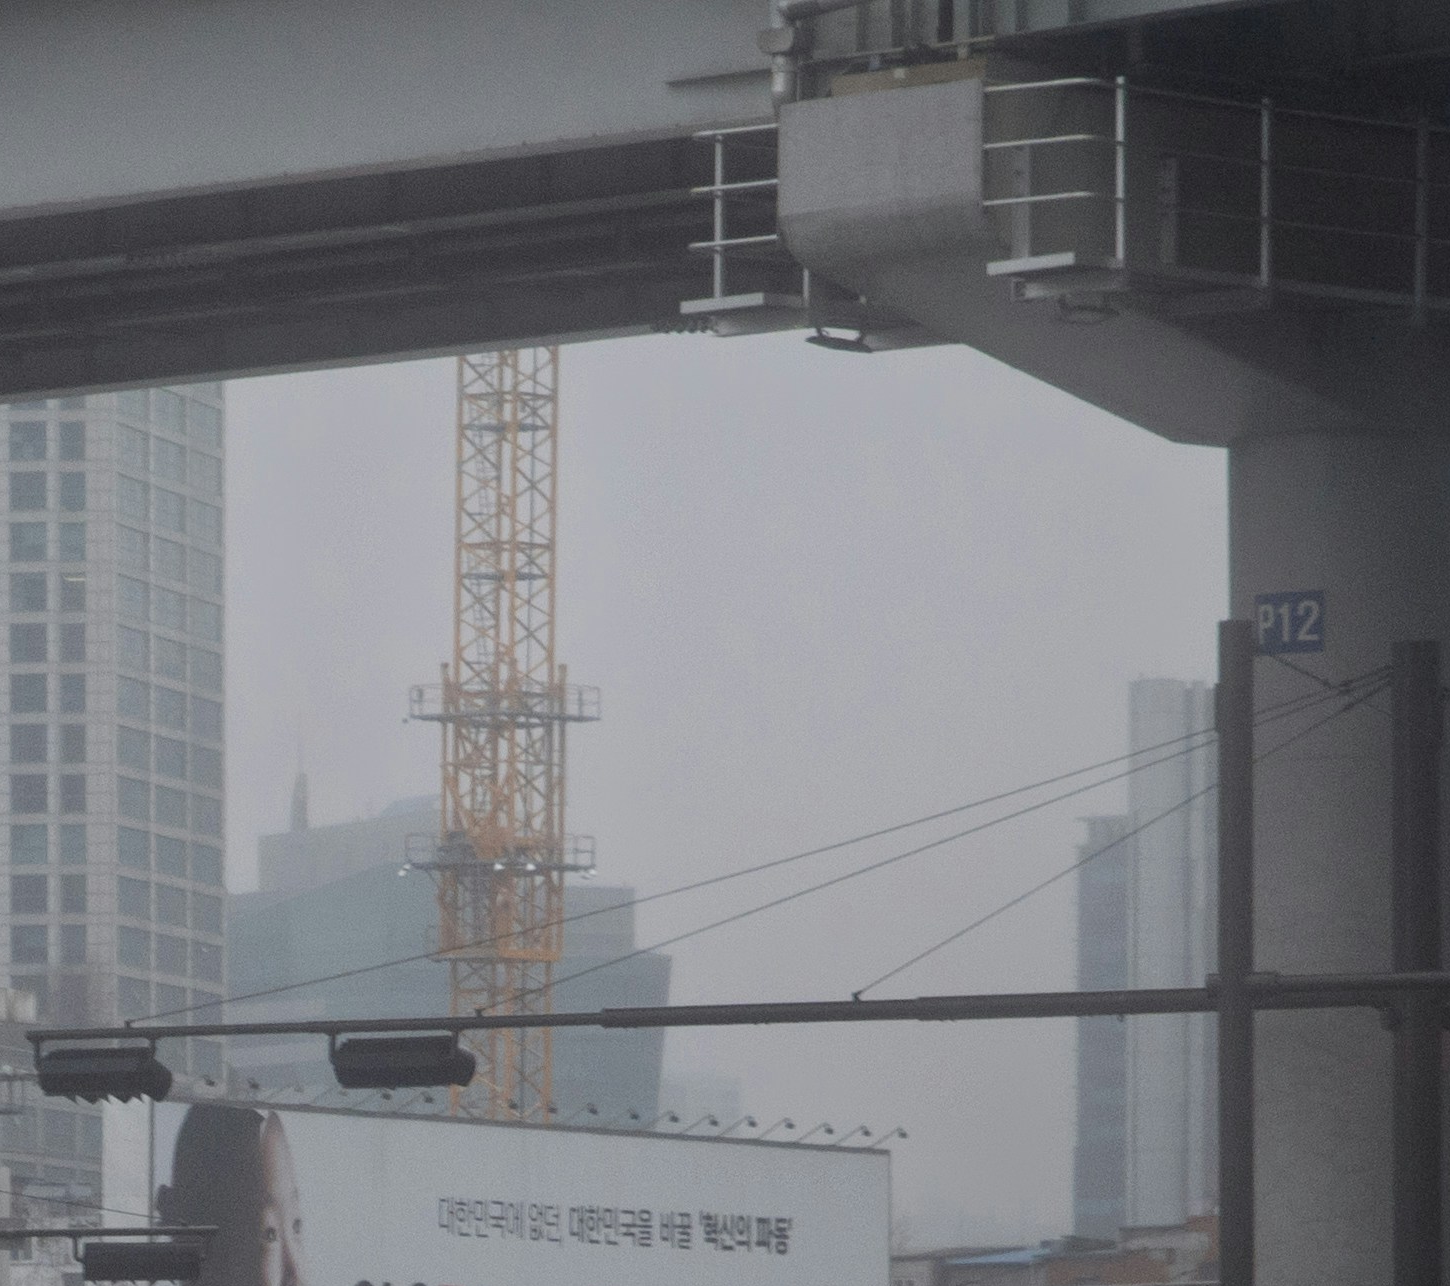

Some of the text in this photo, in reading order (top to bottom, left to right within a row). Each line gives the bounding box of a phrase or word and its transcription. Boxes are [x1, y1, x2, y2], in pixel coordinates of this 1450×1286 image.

[1257, 598, 1321, 645] P12
[438, 1197, 524, 1239] 대한민국에
[568, 1204, 653, 1248] 대한민국을
[658, 1209, 692, 1250] 바꿀
